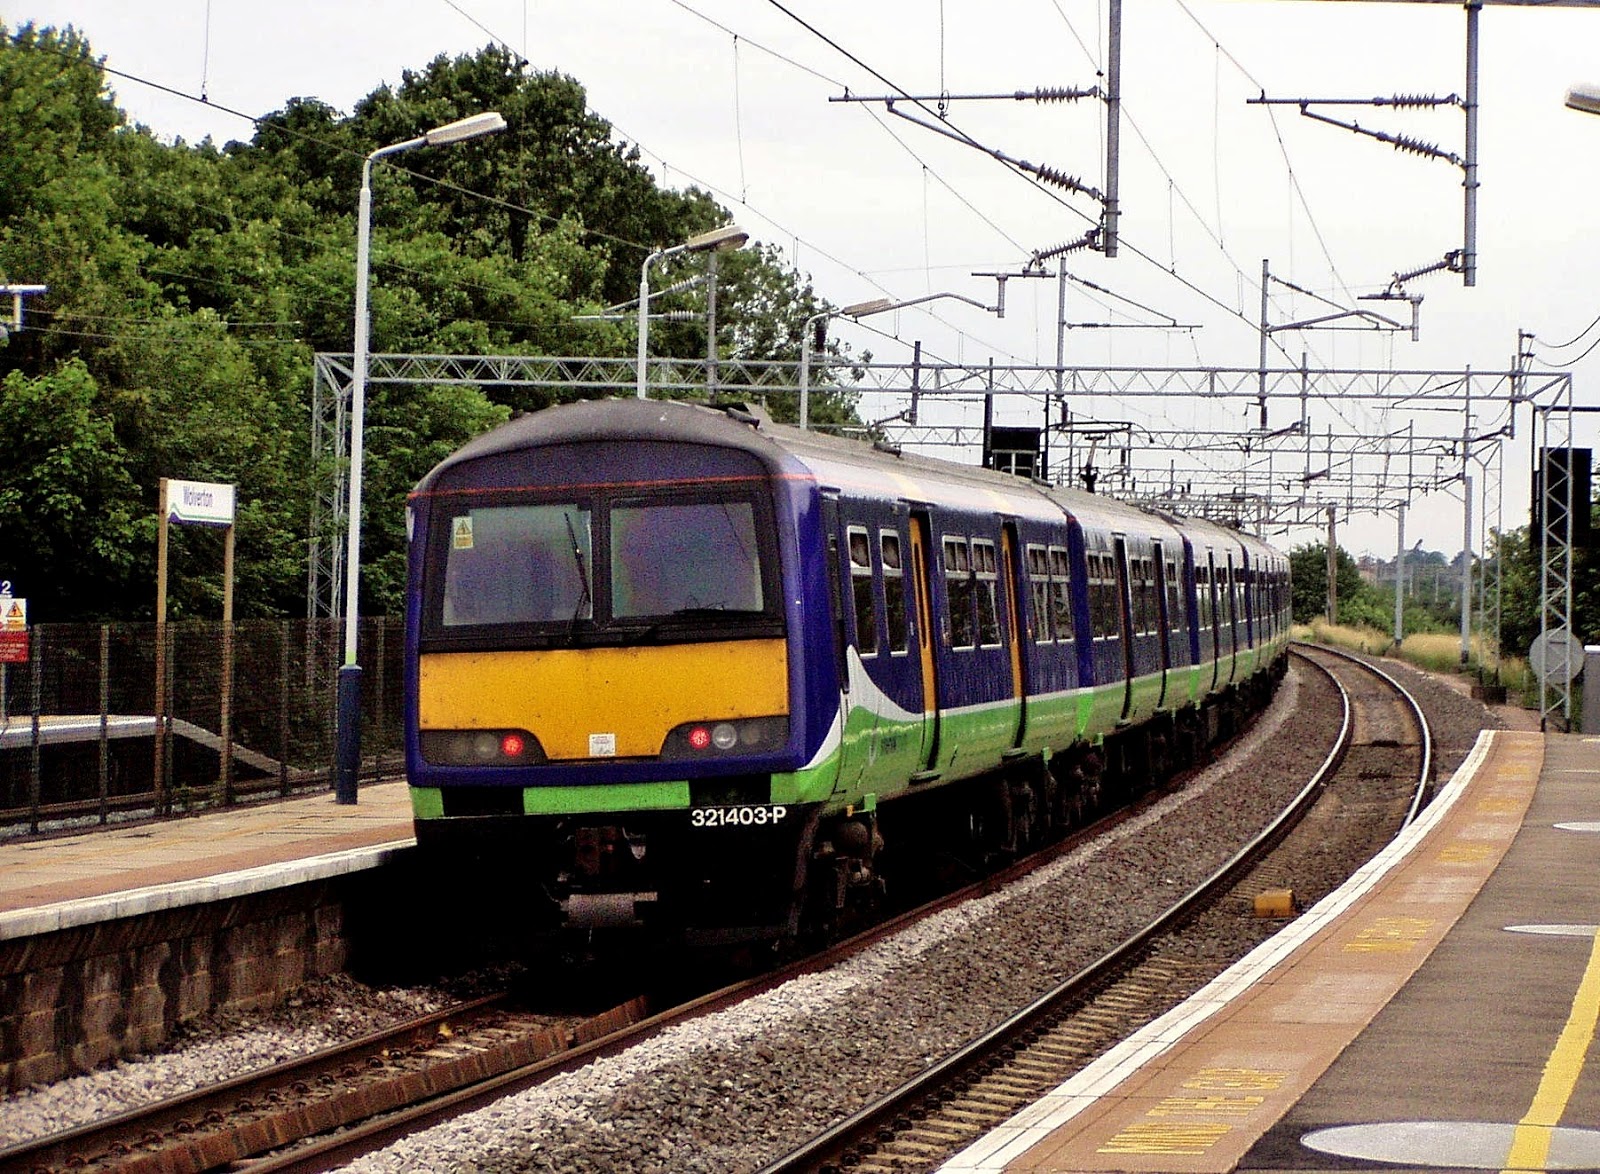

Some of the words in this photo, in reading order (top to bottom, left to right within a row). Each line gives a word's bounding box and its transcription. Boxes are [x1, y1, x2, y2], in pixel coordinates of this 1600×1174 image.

[183, 486, 213, 507] Wolverton
[1, 580, 12, 594] 2
[691, 806, 787, 827] 321403-P
